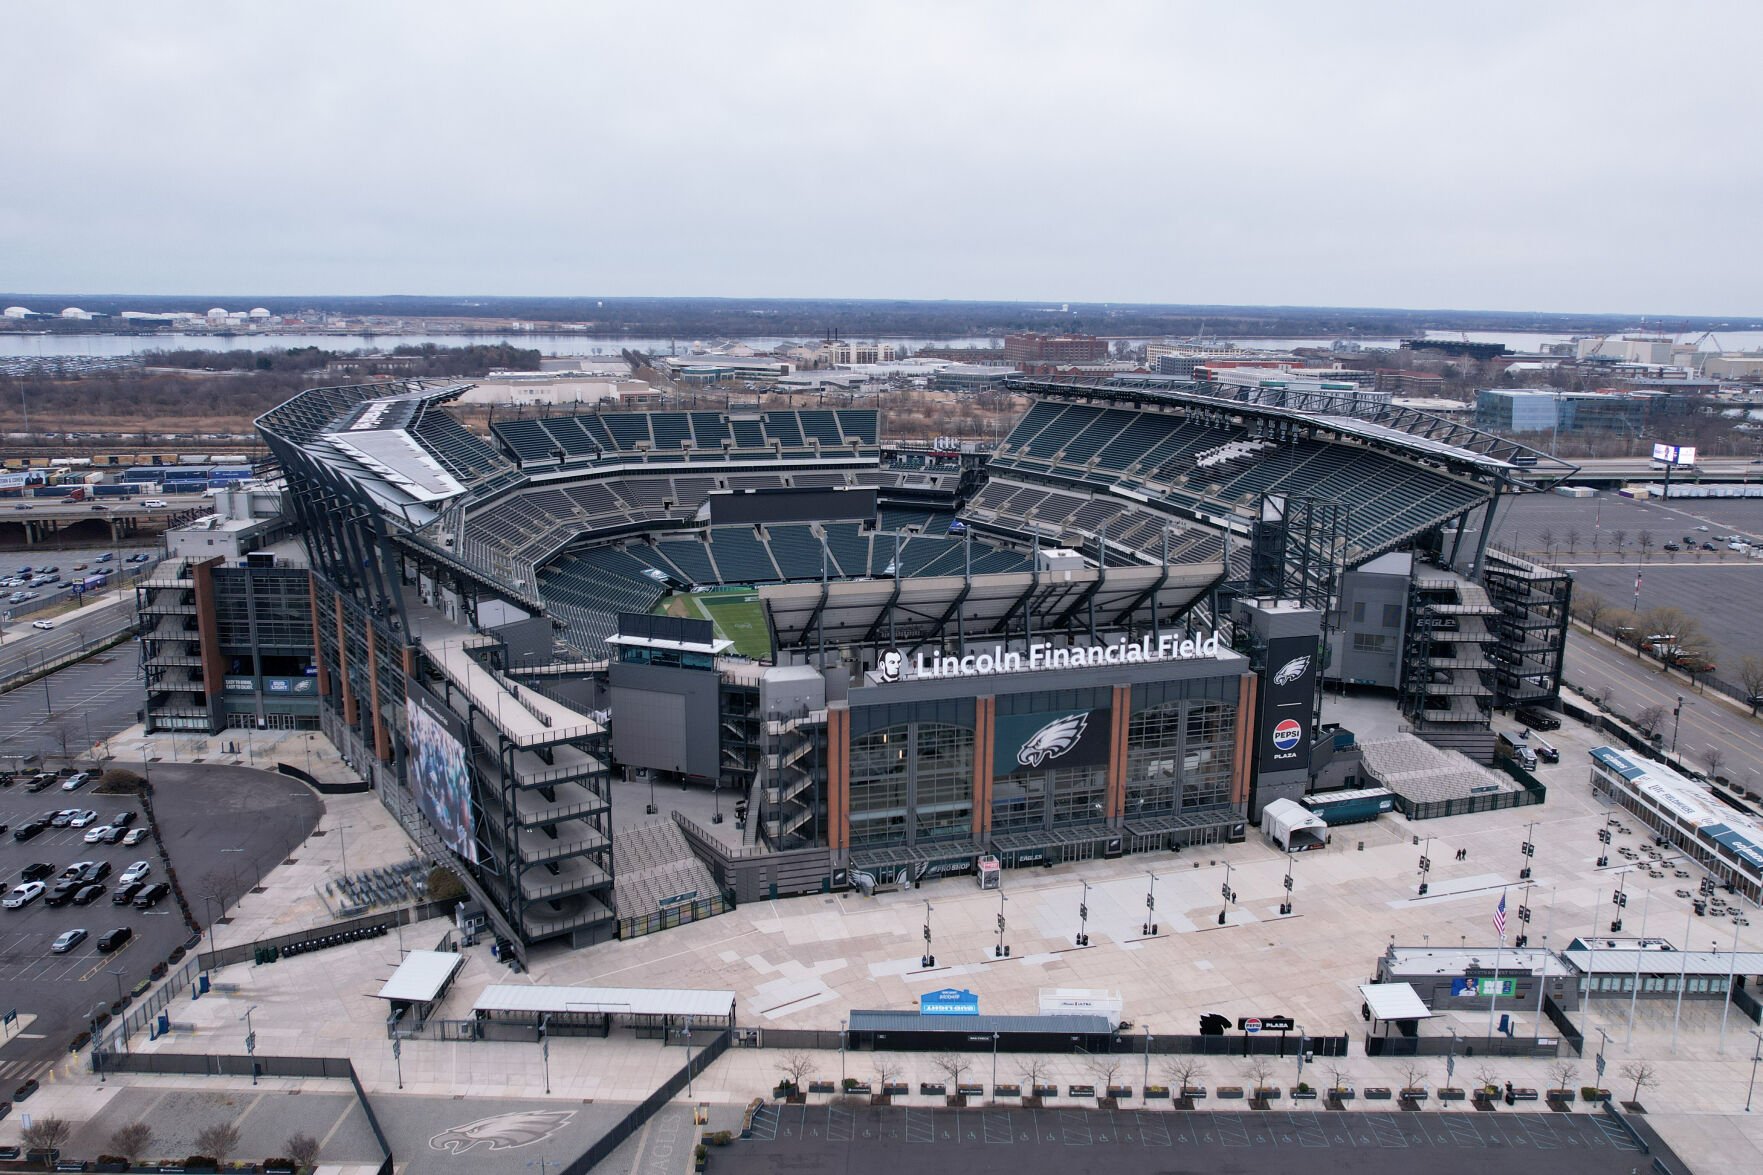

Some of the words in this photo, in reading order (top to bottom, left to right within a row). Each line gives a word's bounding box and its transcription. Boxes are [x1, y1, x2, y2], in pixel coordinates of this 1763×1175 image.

[917, 646, 1020, 677] Lincoln
[1029, 635, 1150, 668] Financial
[1158, 630, 1219, 658] Field
[1275, 730, 1300, 739] PEPSI
[1020, 854, 1043, 862] EAGLES
[937, 864, 952, 873] PRO
[952, 862, 971, 871] SHOP
